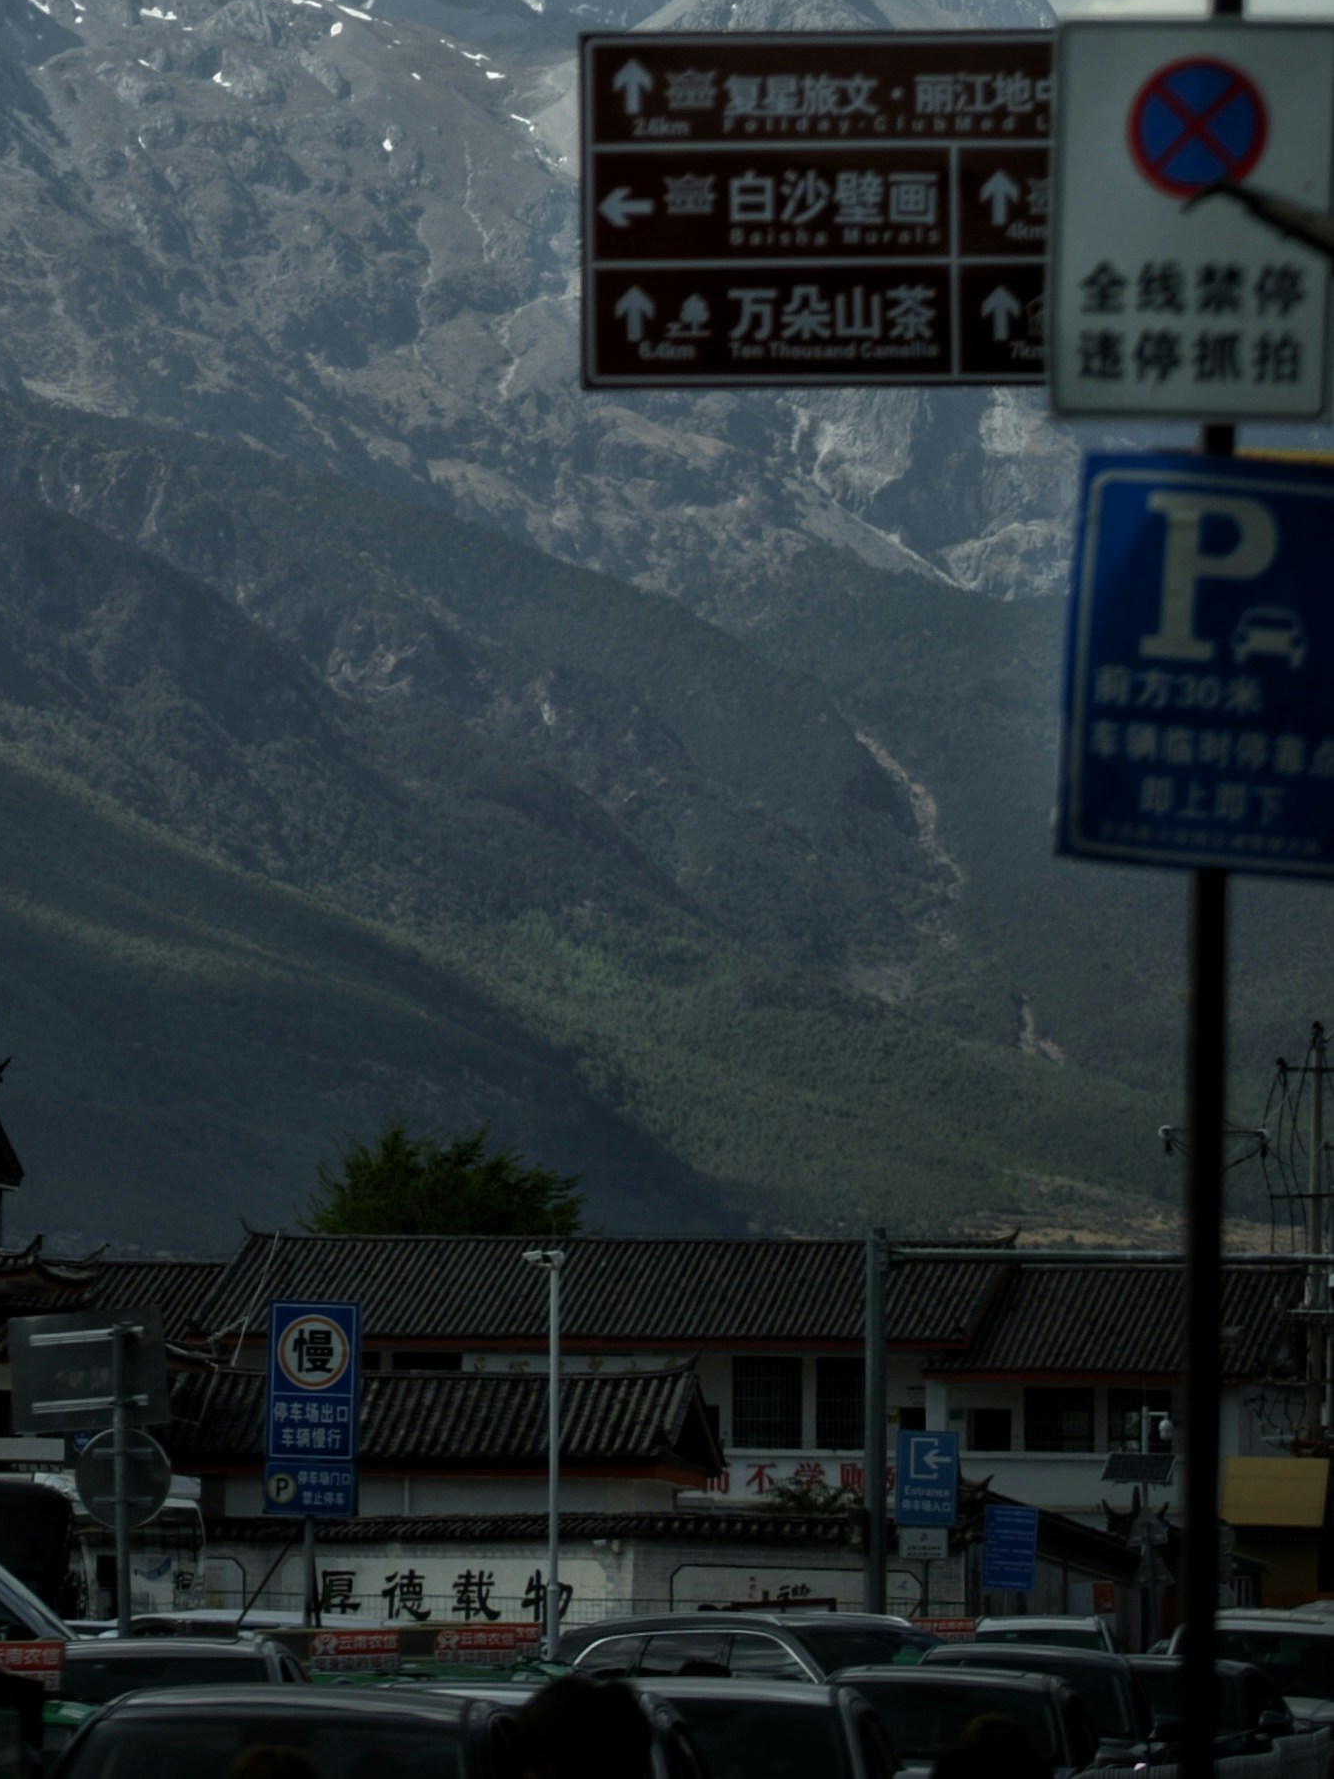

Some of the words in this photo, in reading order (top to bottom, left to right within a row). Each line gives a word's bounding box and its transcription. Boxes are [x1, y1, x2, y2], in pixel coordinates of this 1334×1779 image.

[728, 170, 940, 226] 白沙壁画
[728, 227, 828, 247] Baisha
[842, 226, 941, 245] Murals
[1079, 259, 1304, 316] 全线禁停
[726, 284, 937, 341] 万朵山茶
[729, 340, 764, 359] Ten
[768, 340, 855, 360] Thousand
[1077, 328, 1300, 384] 违停抓拍
[1138, 489, 1282, 664] P
[1138, 775, 1284, 827] 即上即下
[292, 1329, 334, 1373] 慢
[273, 1401, 349, 1424] 停车场出口
[280, 1426, 342, 1449] 车辆慢行
[297, 1471, 351, 1487] 停车场门口
[302, 1490, 346, 1507] 禁止停车
[904, 1485, 951, 1498] Entrance
[901, 1499, 952, 1513] 停车场入口
[318, 1568, 573, 1622] 厚德载物
[338, 1634, 398, 1650] 云南农信
[460, 1631, 515, 1646] 云南农信
